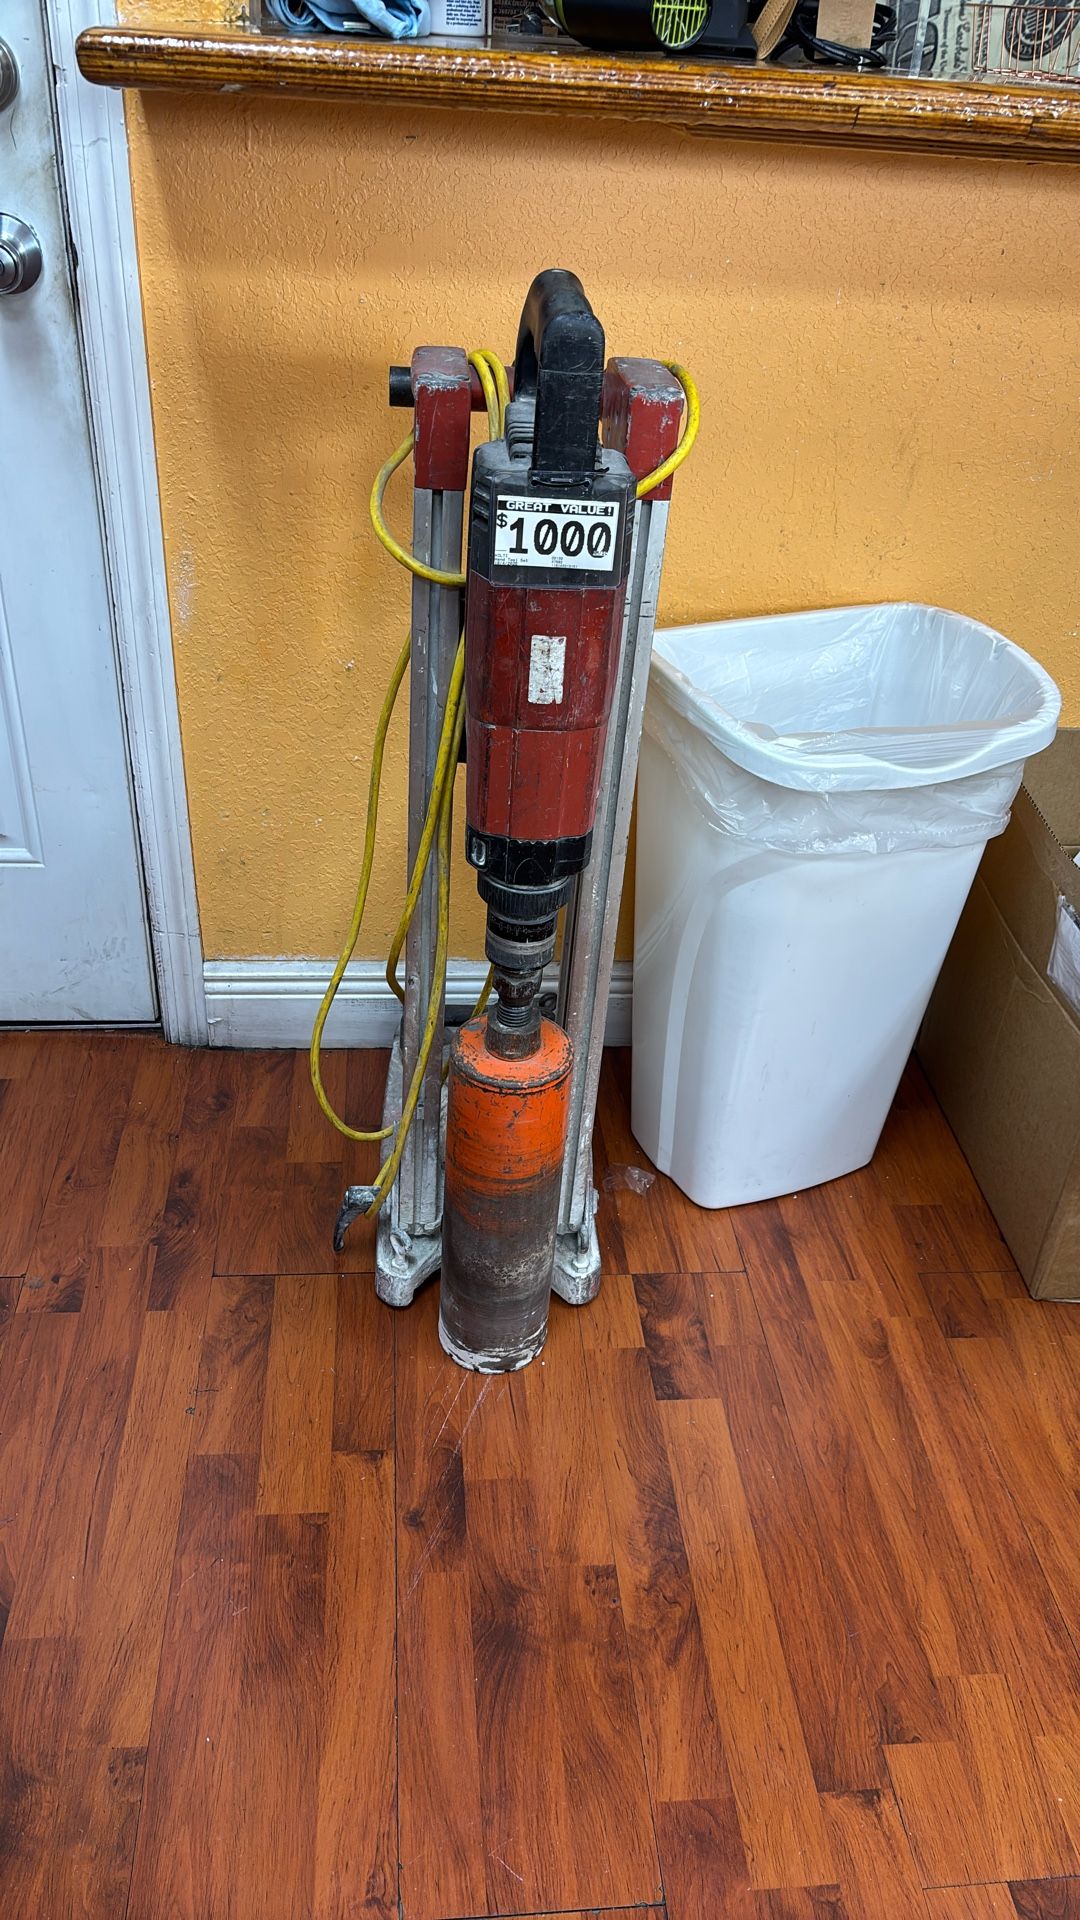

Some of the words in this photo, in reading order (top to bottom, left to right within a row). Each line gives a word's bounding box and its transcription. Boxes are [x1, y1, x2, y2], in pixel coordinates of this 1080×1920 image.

[506, 501, 551, 512] GREAT
[561, 504, 612, 516] VALUE!
[496, 512, 612, 558] $1000
